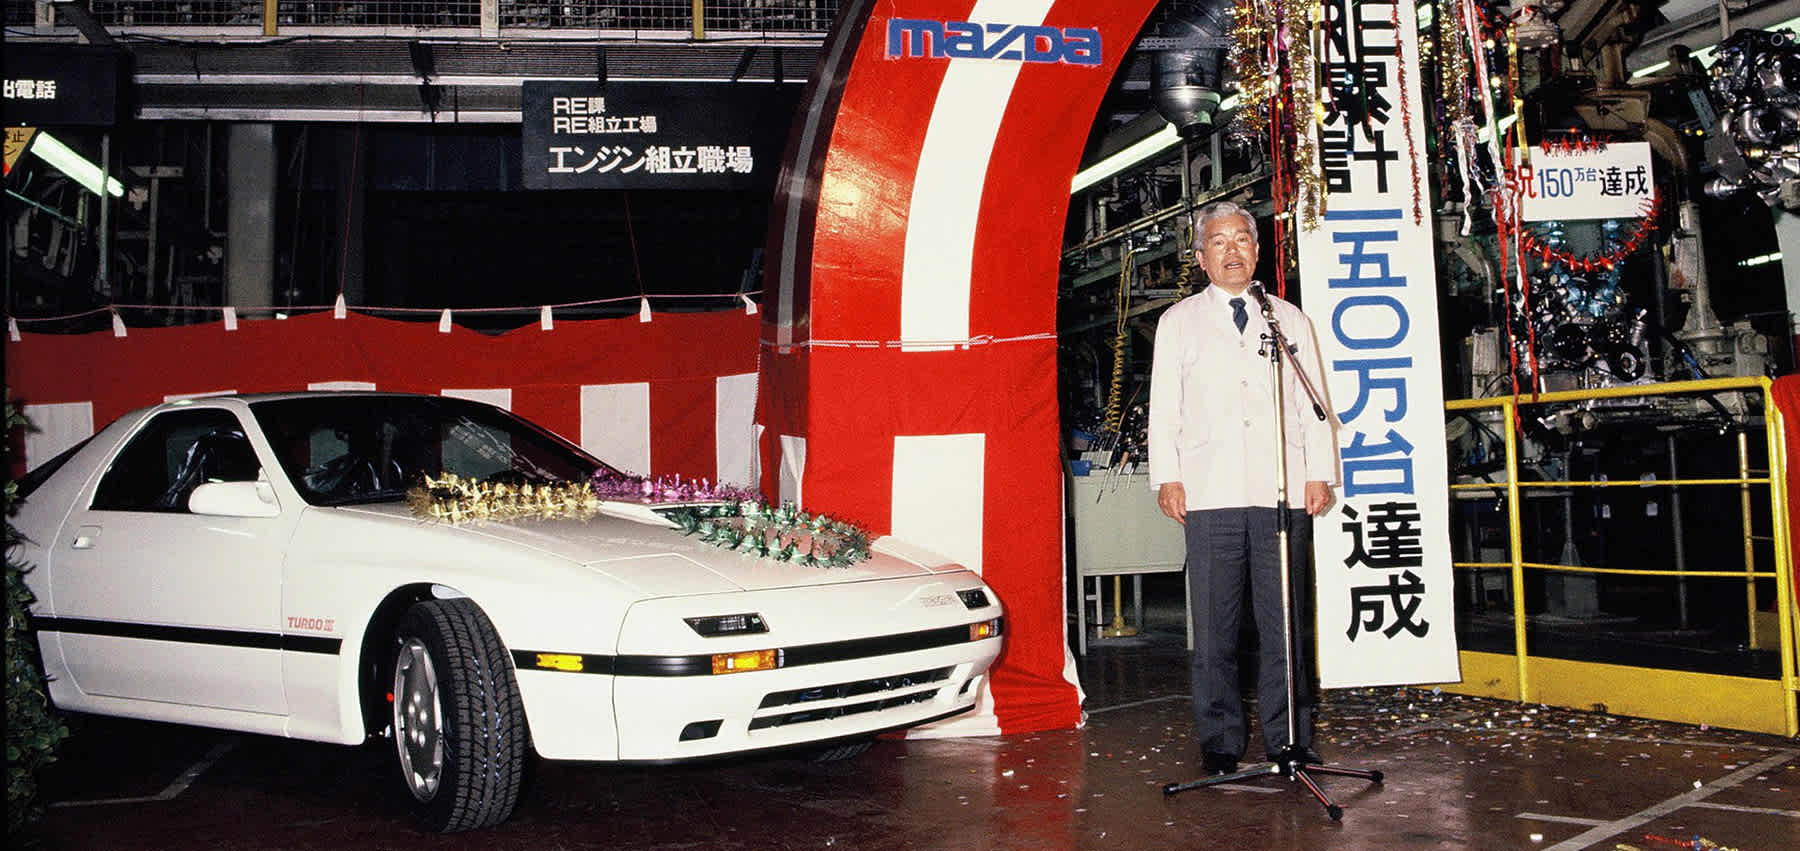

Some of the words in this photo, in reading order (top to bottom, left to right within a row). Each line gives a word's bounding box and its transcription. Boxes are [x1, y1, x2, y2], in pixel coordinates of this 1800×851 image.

[553, 116, 657, 134] RE組立工場
[548, 146, 753, 173] エンジン組立職場
